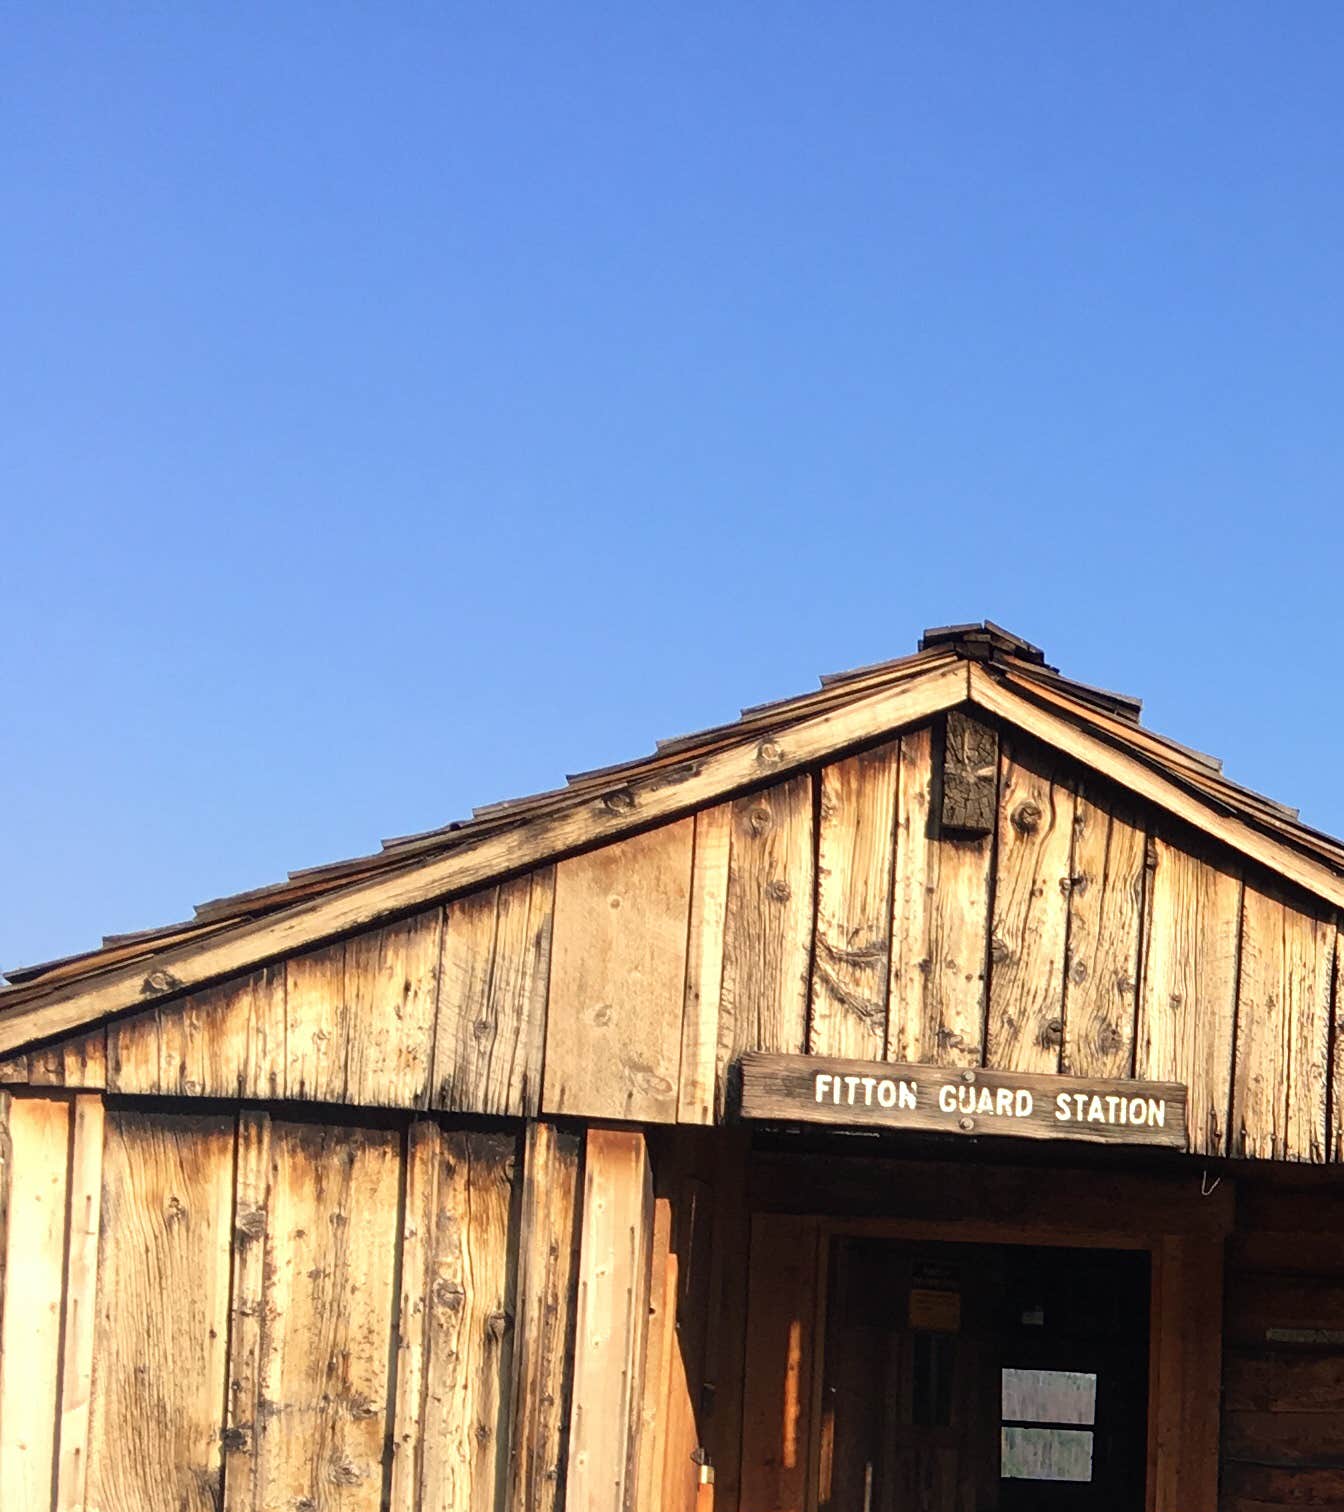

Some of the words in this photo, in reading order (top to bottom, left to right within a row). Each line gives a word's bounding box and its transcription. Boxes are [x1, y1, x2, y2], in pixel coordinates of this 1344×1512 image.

[815, 1074, 918, 1110] FITTON
[938, 1084, 1034, 1118] GUARD
[1055, 1093, 1165, 1127] STATION
